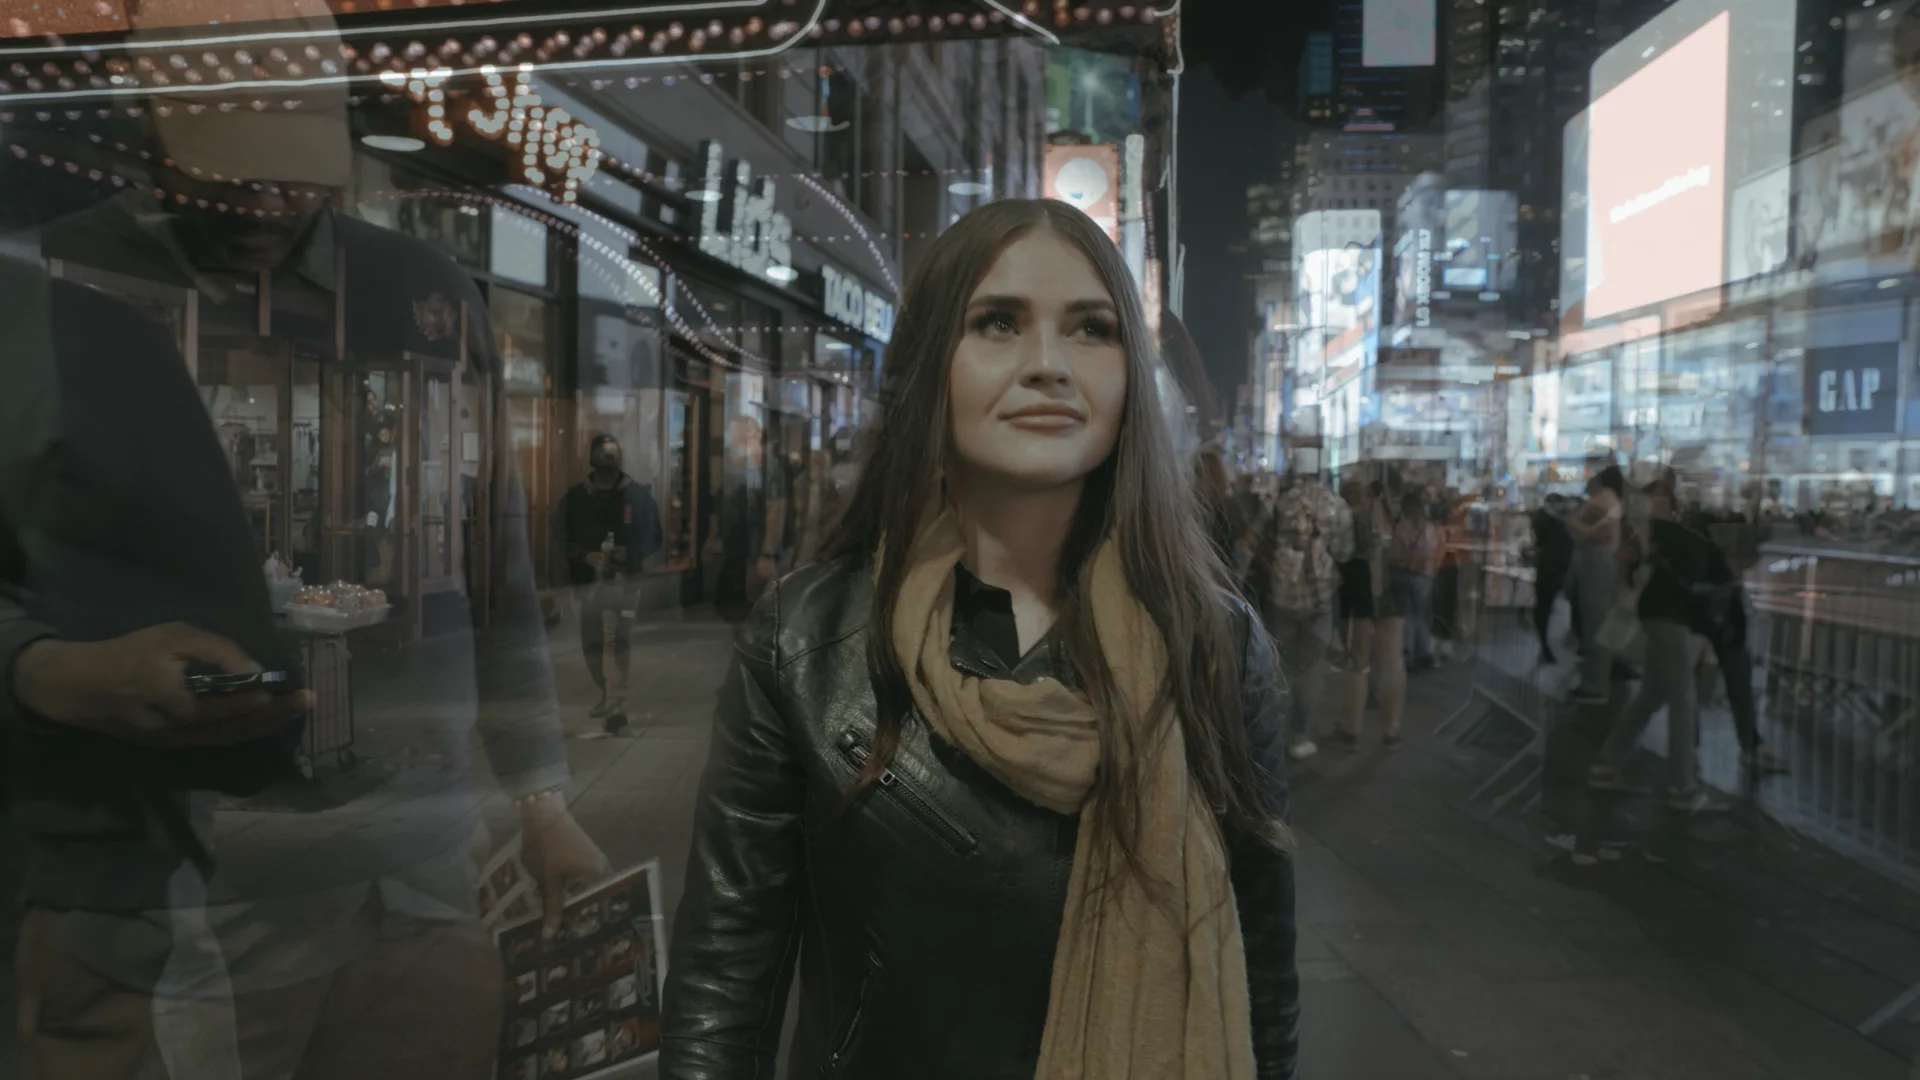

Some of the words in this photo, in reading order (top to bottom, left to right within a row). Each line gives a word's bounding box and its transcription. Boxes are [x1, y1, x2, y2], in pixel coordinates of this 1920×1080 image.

[699, 139, 791, 288] Lids
[822, 264, 863, 332] TACO
[1818, 366, 1880, 413] GAP
